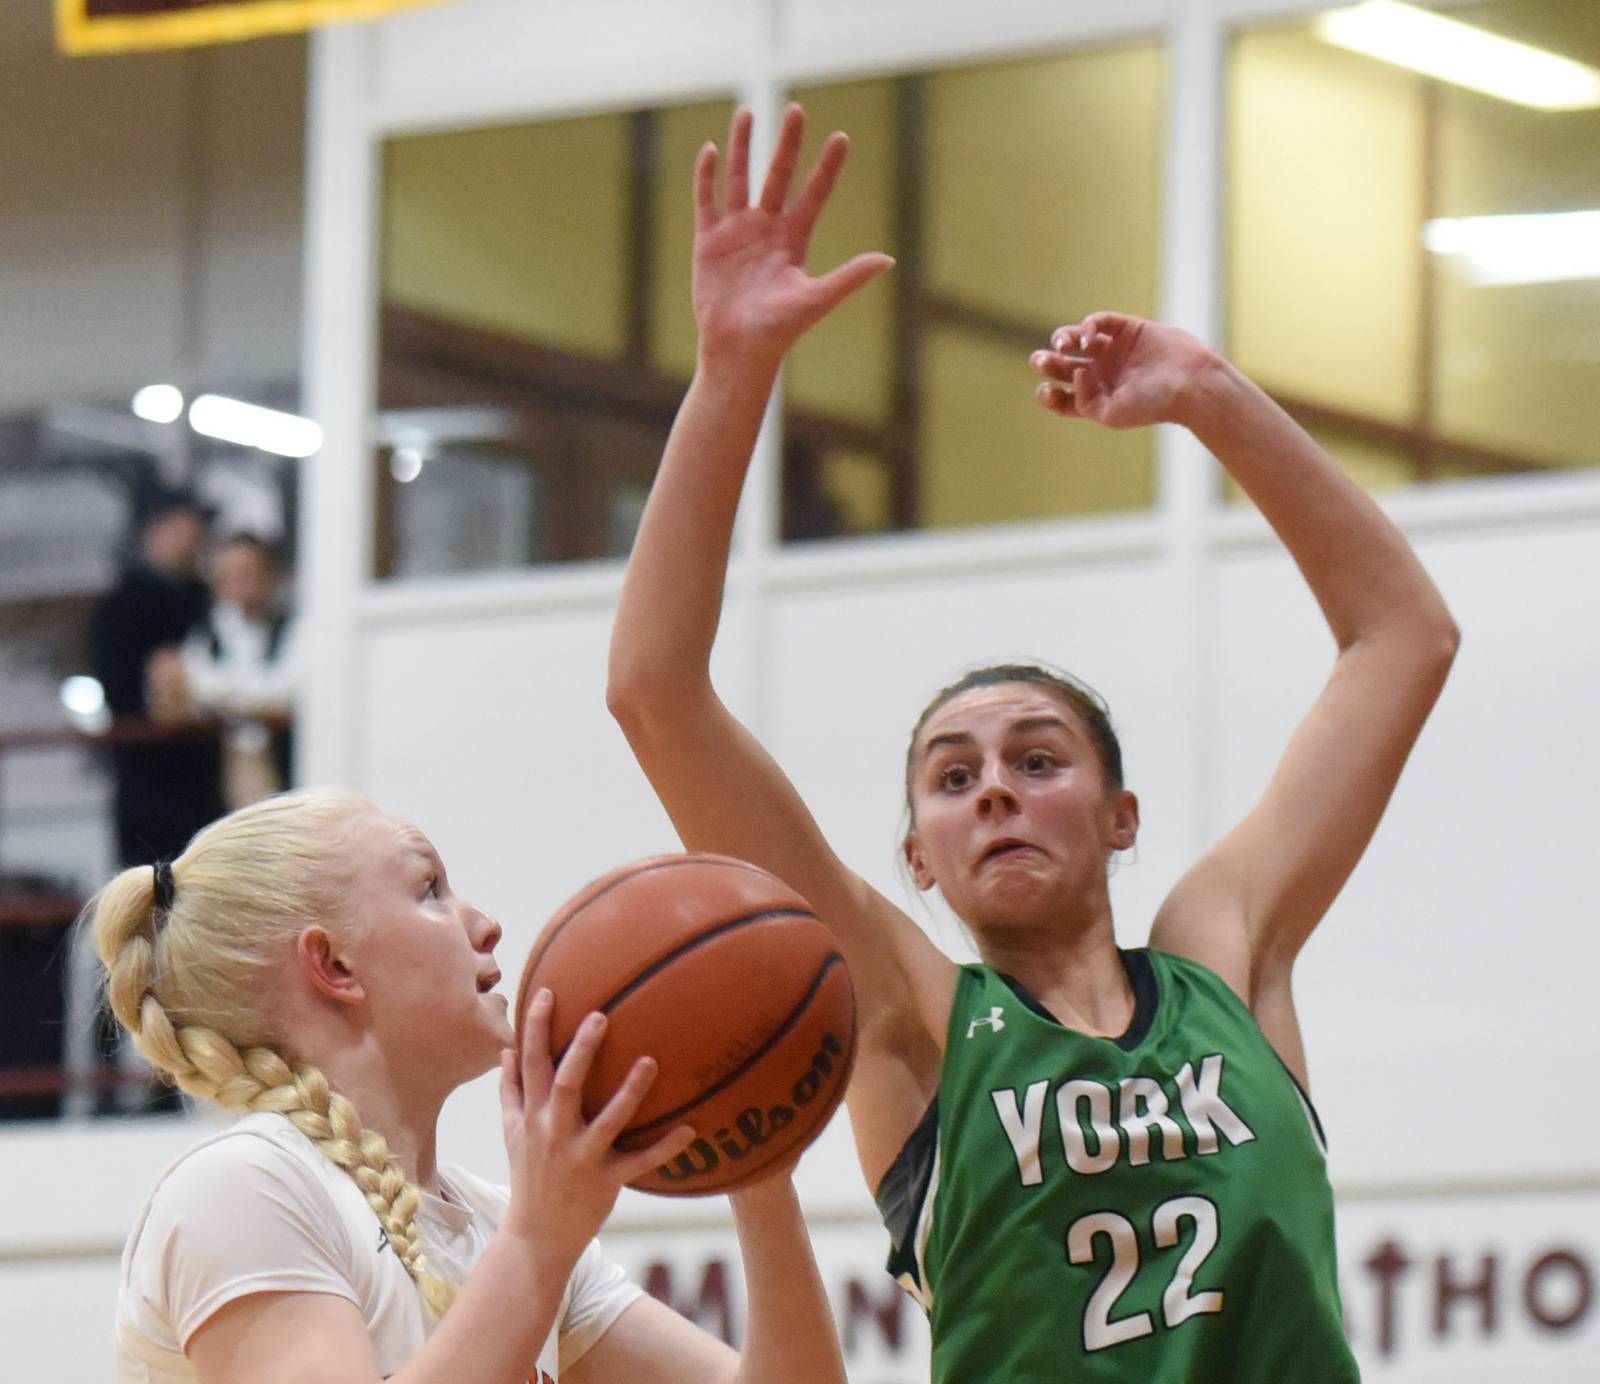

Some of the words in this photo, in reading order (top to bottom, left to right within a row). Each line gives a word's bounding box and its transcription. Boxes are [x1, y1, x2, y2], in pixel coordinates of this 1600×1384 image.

[656, 1032, 842, 1182] Wilson
[990, 1053, 1258, 1188] YORK
[1066, 1193, 1224, 1352] 22
